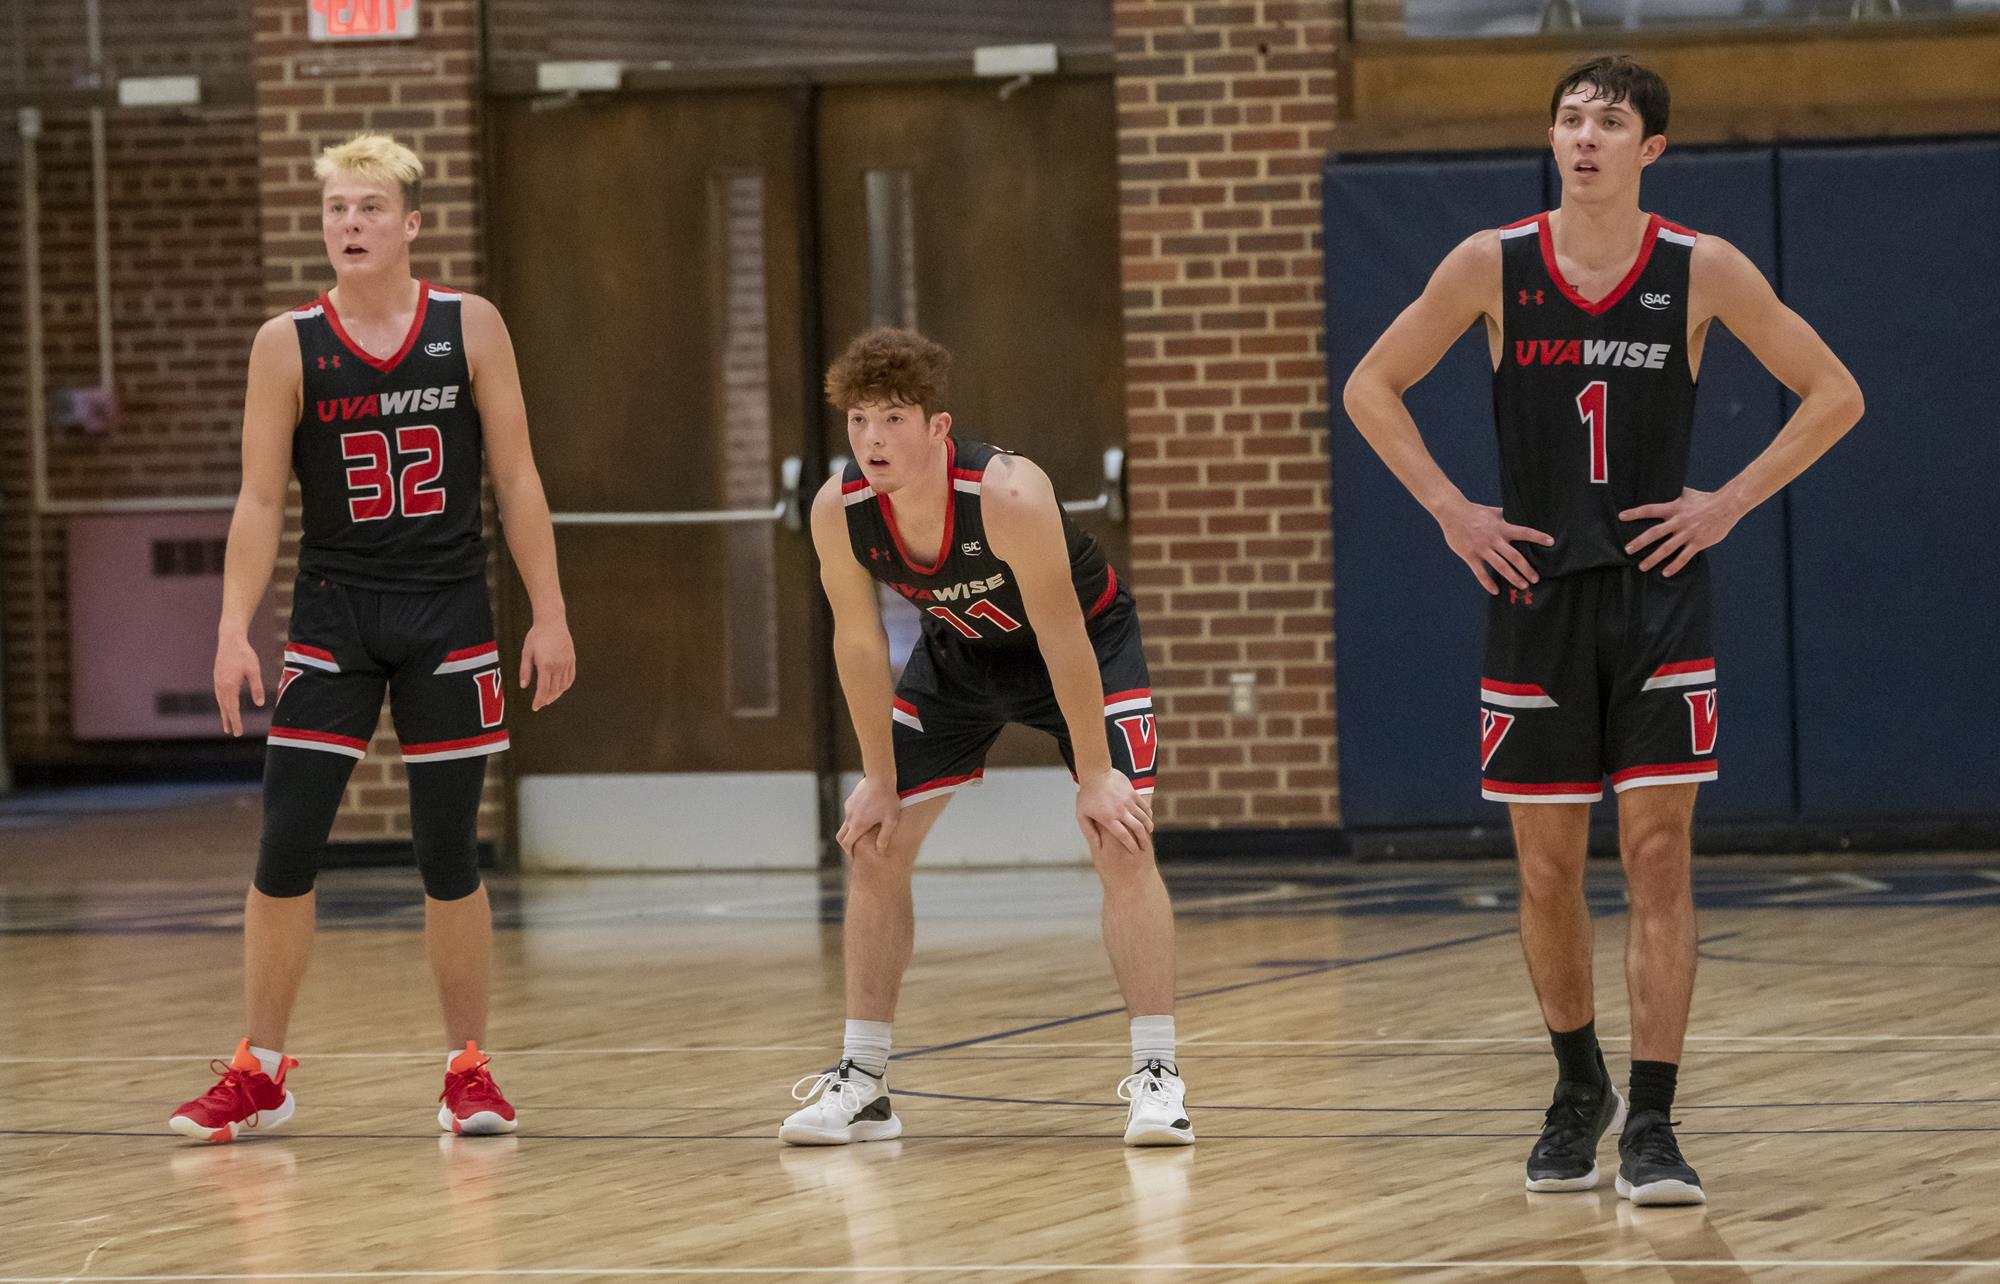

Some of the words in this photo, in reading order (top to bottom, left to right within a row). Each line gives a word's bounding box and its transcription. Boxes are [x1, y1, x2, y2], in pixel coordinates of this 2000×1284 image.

[1643, 292, 1671, 305] SAC
[427, 341, 452, 353] SAC
[1515, 339, 1671, 369] UVAWISE
[316, 385, 460, 423] UVAWISE
[1576, 380, 1609, 484] 1
[340, 424, 447, 523] 32
[962, 540, 982, 552] SAC
[890, 573, 1005, 602] VAWISE
[926, 598, 1022, 639] 11
